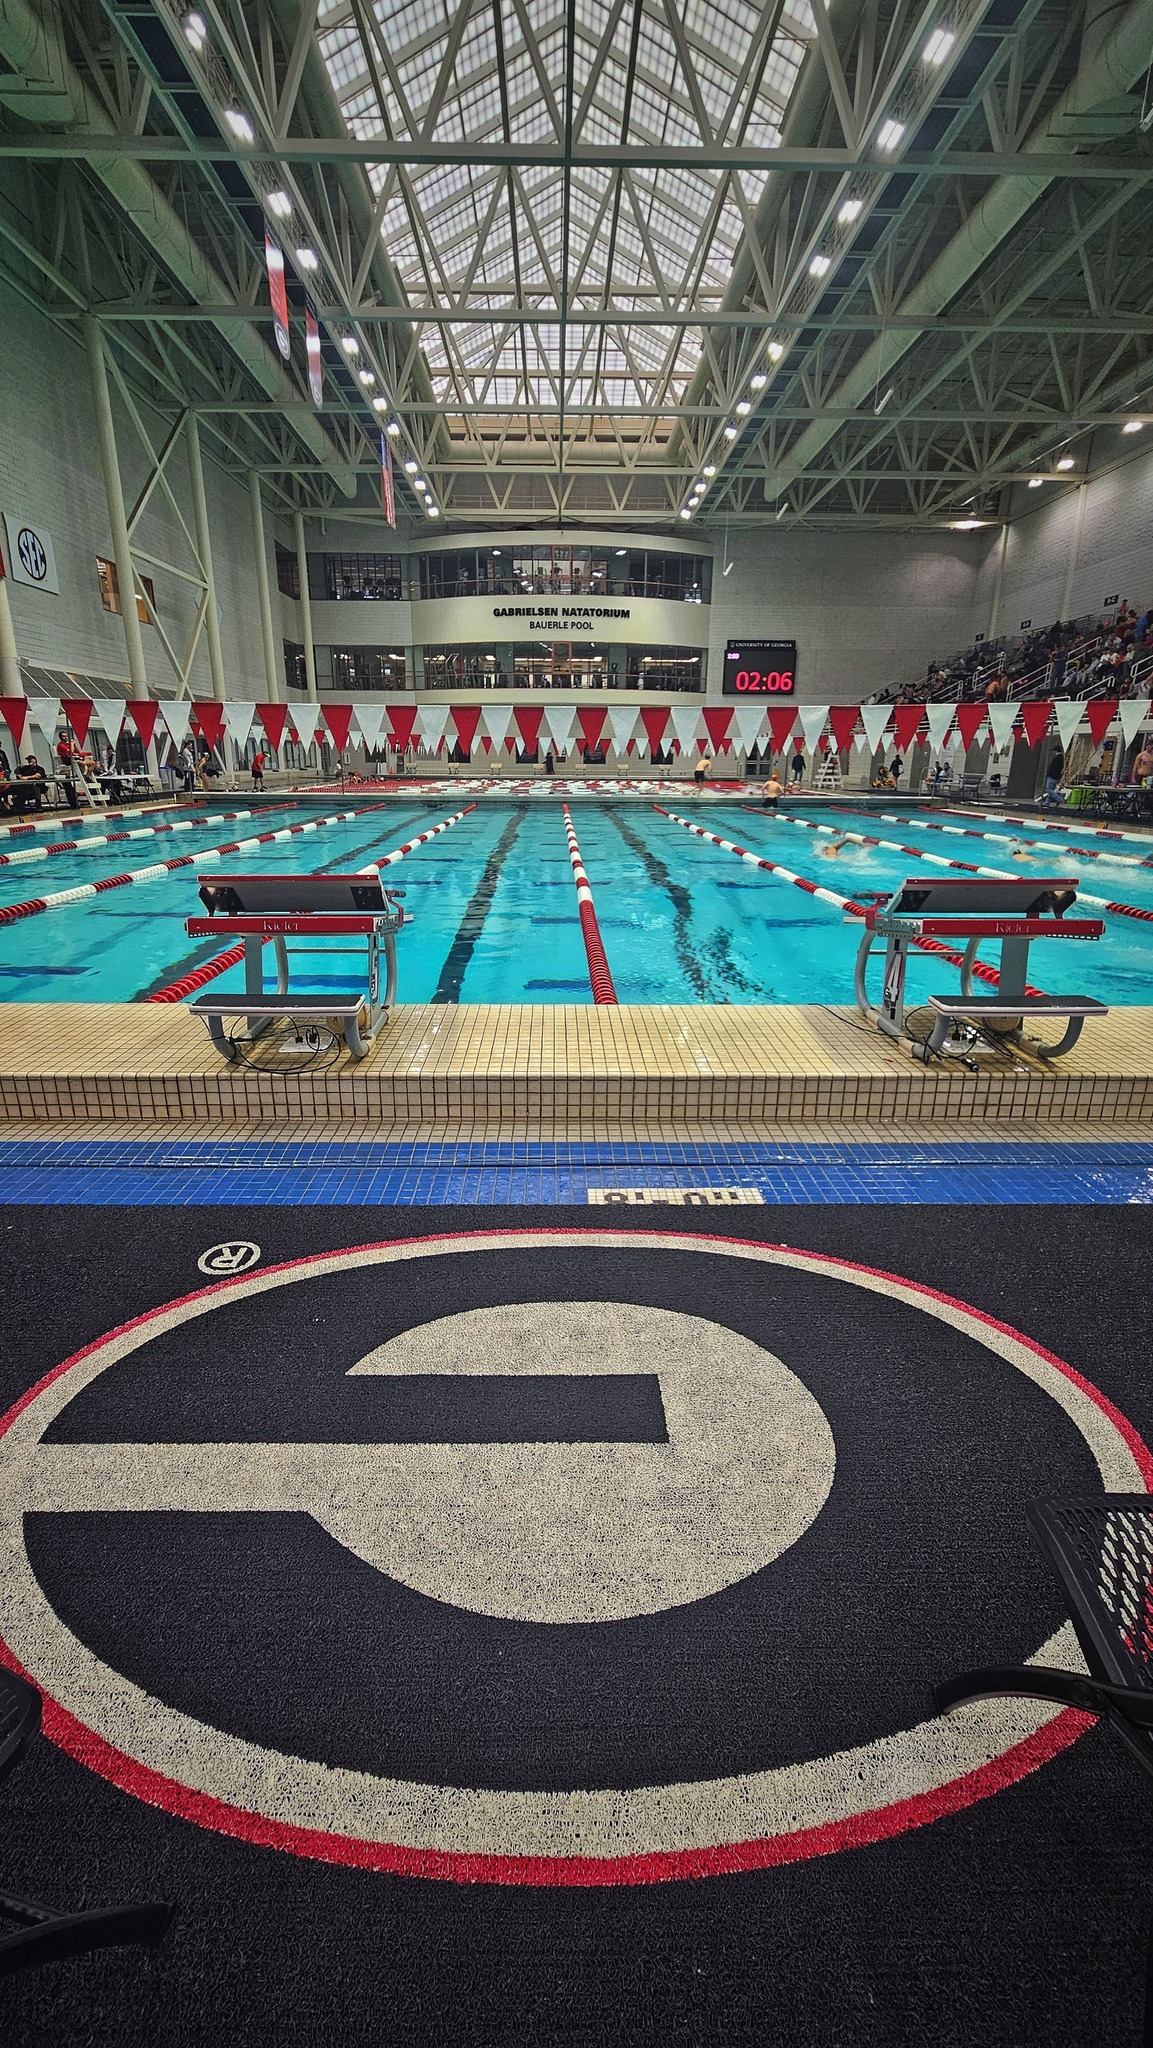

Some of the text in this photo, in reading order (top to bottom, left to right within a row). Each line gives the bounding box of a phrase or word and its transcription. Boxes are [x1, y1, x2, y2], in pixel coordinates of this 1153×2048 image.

[19, 530, 46, 579] SEC
[493, 607, 630, 618] GABRIELSEN NATATORIUM
[529, 621, 594, 630] BAUERLE POOL
[736, 671, 793, 691] 02:06
[886, 953, 902, 1002] 4
